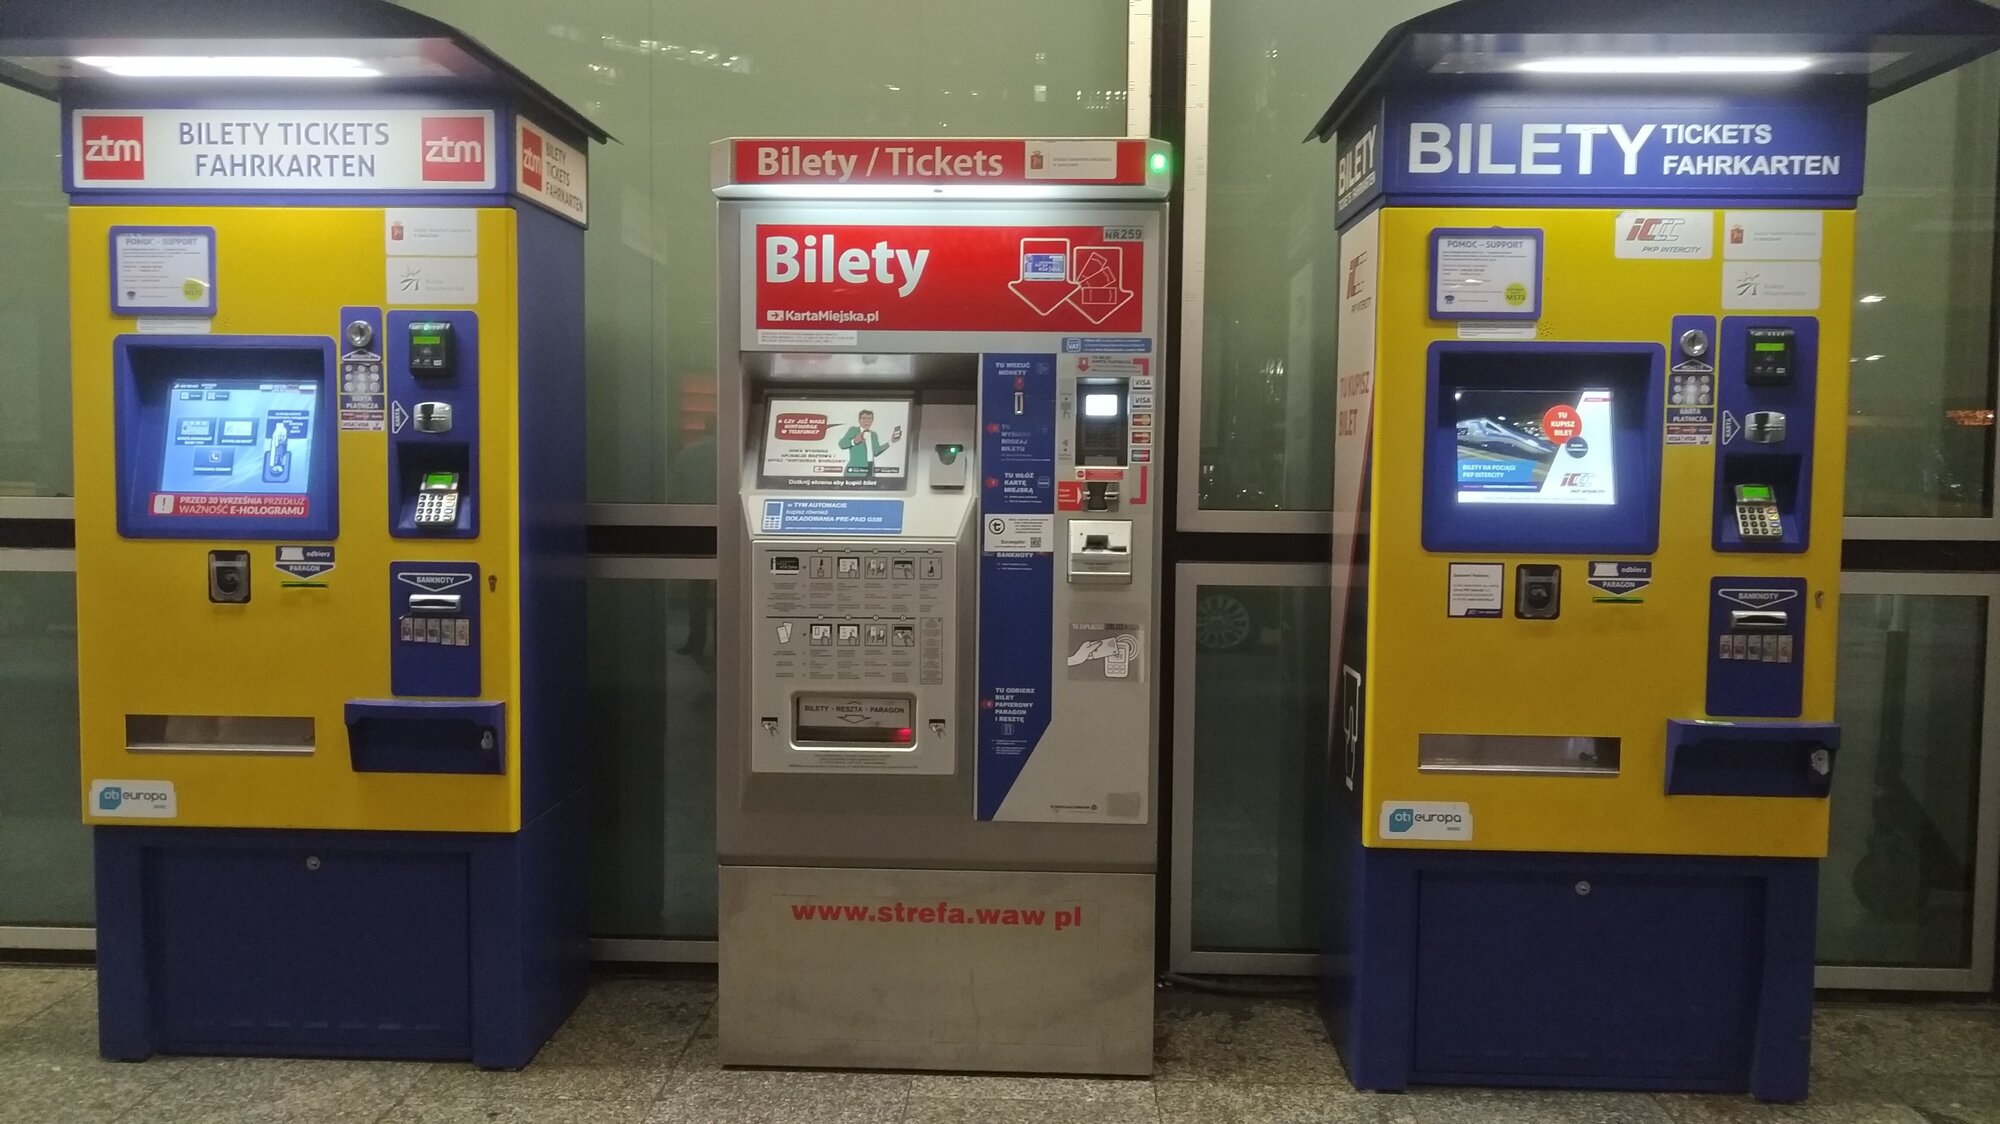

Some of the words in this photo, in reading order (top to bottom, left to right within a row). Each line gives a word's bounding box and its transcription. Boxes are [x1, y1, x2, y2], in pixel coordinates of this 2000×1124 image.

[179, 122, 270, 146] BILETY
[278, 122, 390, 146] TICKETS
[1661, 124, 1773, 144] TICKETS
[85, 135, 142, 162] ztm
[425, 136, 482, 163] ztm
[1408, 122, 1657, 176] BILETY
[195, 154, 376, 177] FAHRKARTEN
[757, 146, 857, 183] Bilety
[865, 146, 880, 177] /
[884, 146, 1003, 177] Tickets
[1338, 124, 1377, 197] BILETY
[1662, 155, 1841, 176] FAHRKARTEN
[1447, 240, 1478, 249] POMOC
[1486, 240, 1524, 249] SUPPORT
[1660, 246, 1703, 254] INTERCITY
[765, 234, 931, 298] Bilety
[785, 310, 880, 324] KartaMiejska.pl
[1557, 411, 1568, 419] TU
[179, 496, 207, 504] PRZED
[208, 496, 219, 504] 30
[219, 495, 263, 505] WRZEŚNIA
[230, 505, 305, 516] E-HOLOGRAMU
[306, 550, 331, 558] odbierz
[289, 565, 320, 573] PARAGON
[1620, 565, 1647, 574] odbierz
[416, 576, 455, 585] BANKNOTY
[1602, 580, 1636, 589] PARAGON
[1738, 592, 1780, 600] BANKNOTY
[836, 705, 863, 713] RESZTA
[869, 706, 905, 714] PARAGON
[122, 791, 168, 803] europa
[1414, 813, 1462, 825] europa
